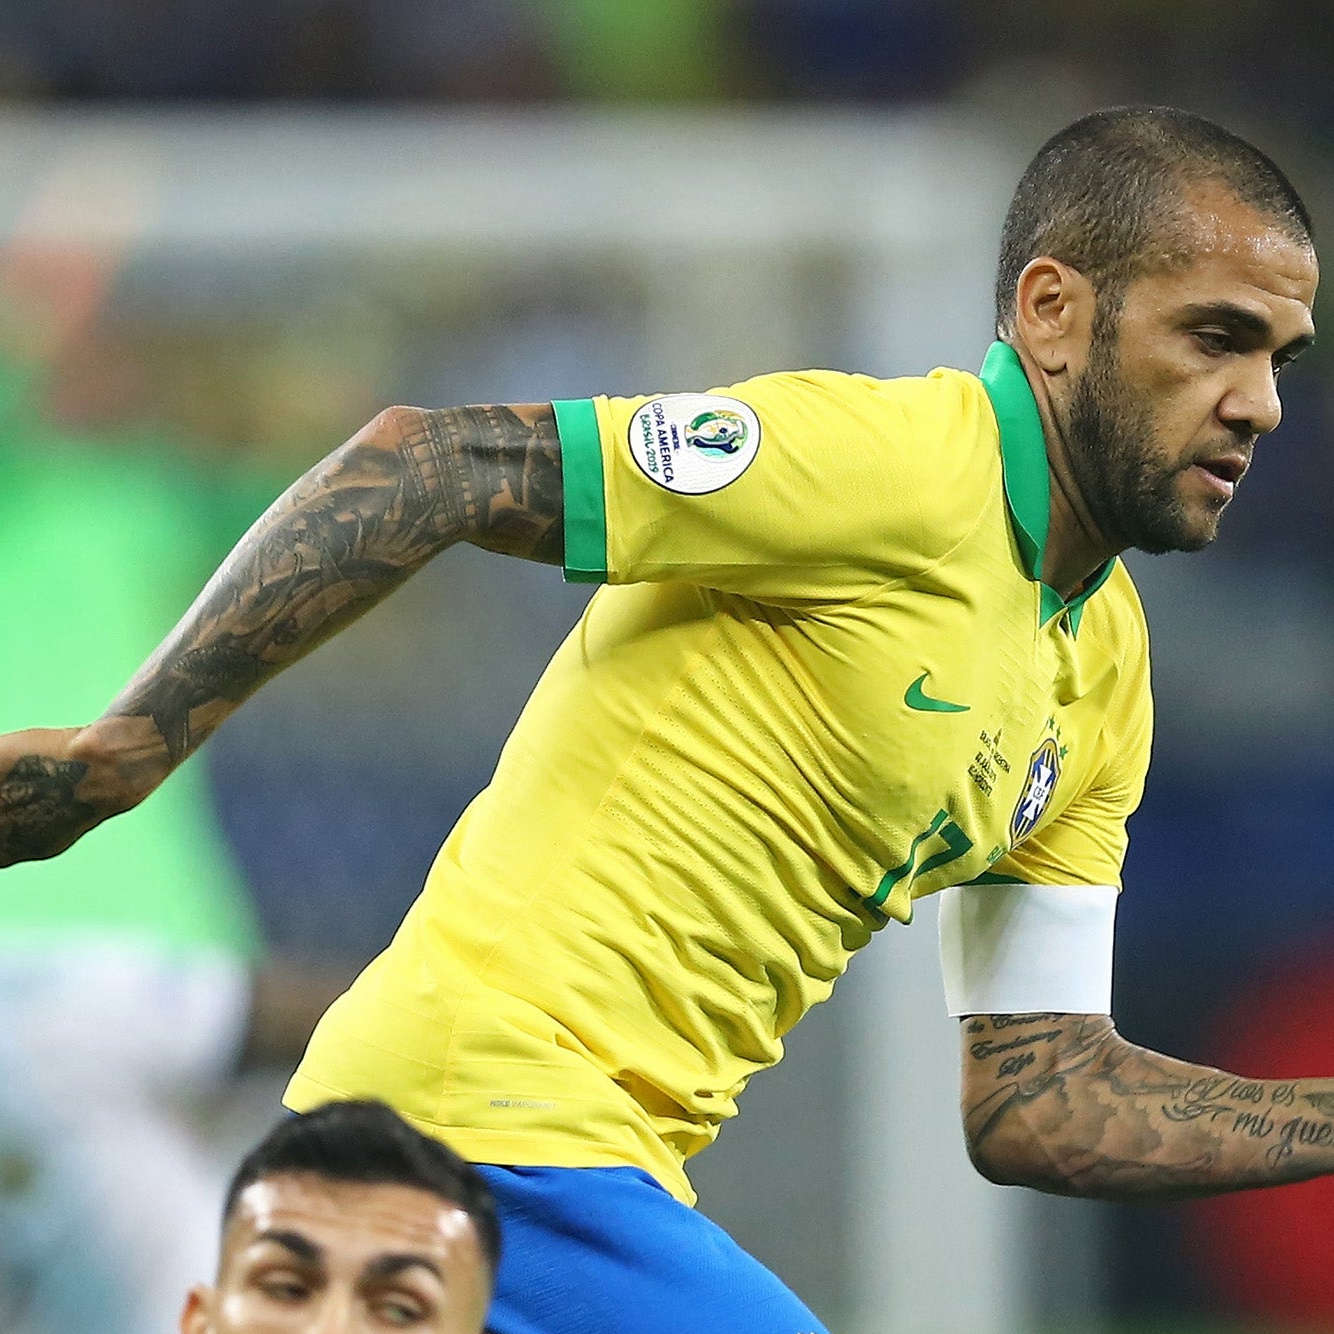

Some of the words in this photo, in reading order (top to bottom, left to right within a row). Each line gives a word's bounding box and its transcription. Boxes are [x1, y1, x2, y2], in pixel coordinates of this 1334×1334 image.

[652, 402, 665, 427] COPA
[646, 449, 659, 473] 2019
[657, 429, 674, 483] AMERICA
